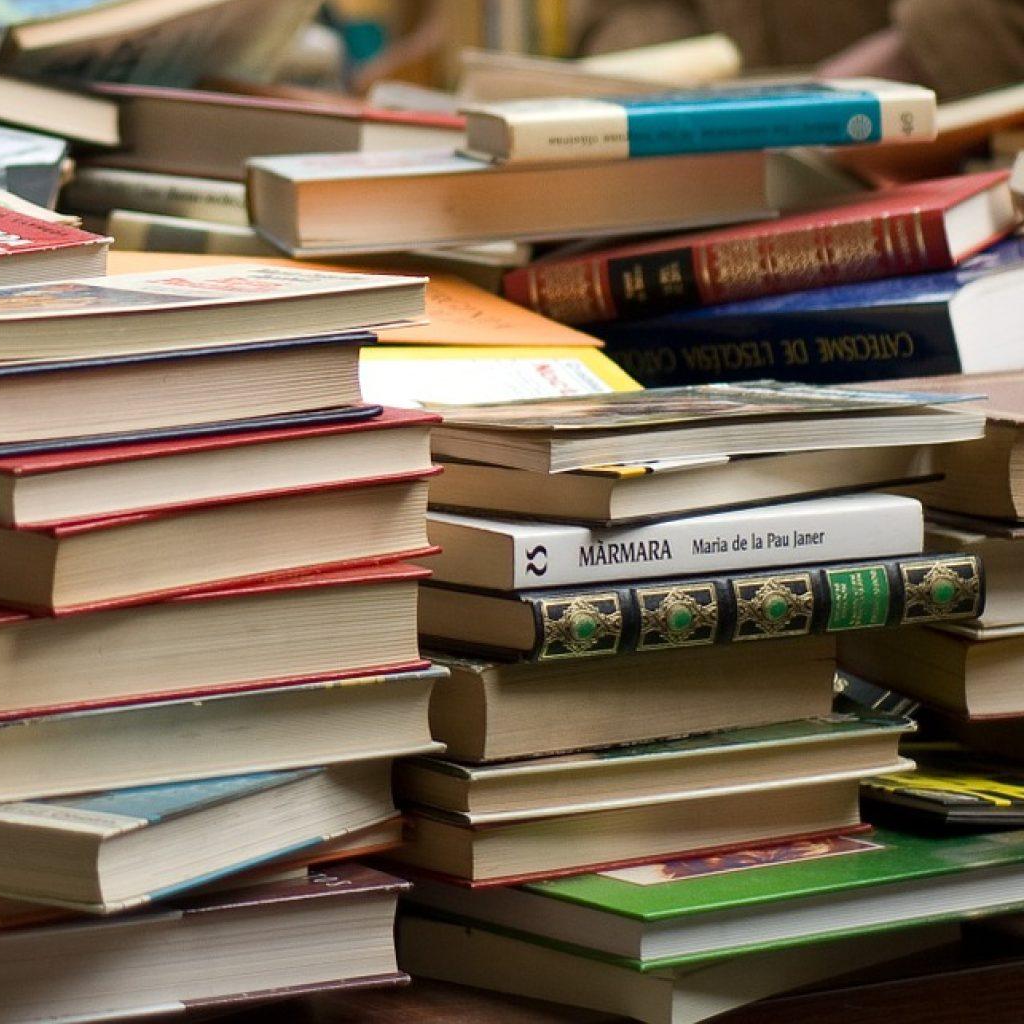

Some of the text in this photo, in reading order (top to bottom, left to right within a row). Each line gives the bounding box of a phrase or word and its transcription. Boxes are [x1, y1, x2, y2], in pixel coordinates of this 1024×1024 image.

[778, 337, 809, 365] DE
[816, 330, 914, 363] CATECISME
[579, 530, 825, 567] MÀRMARA Maria de la Pau Janer
